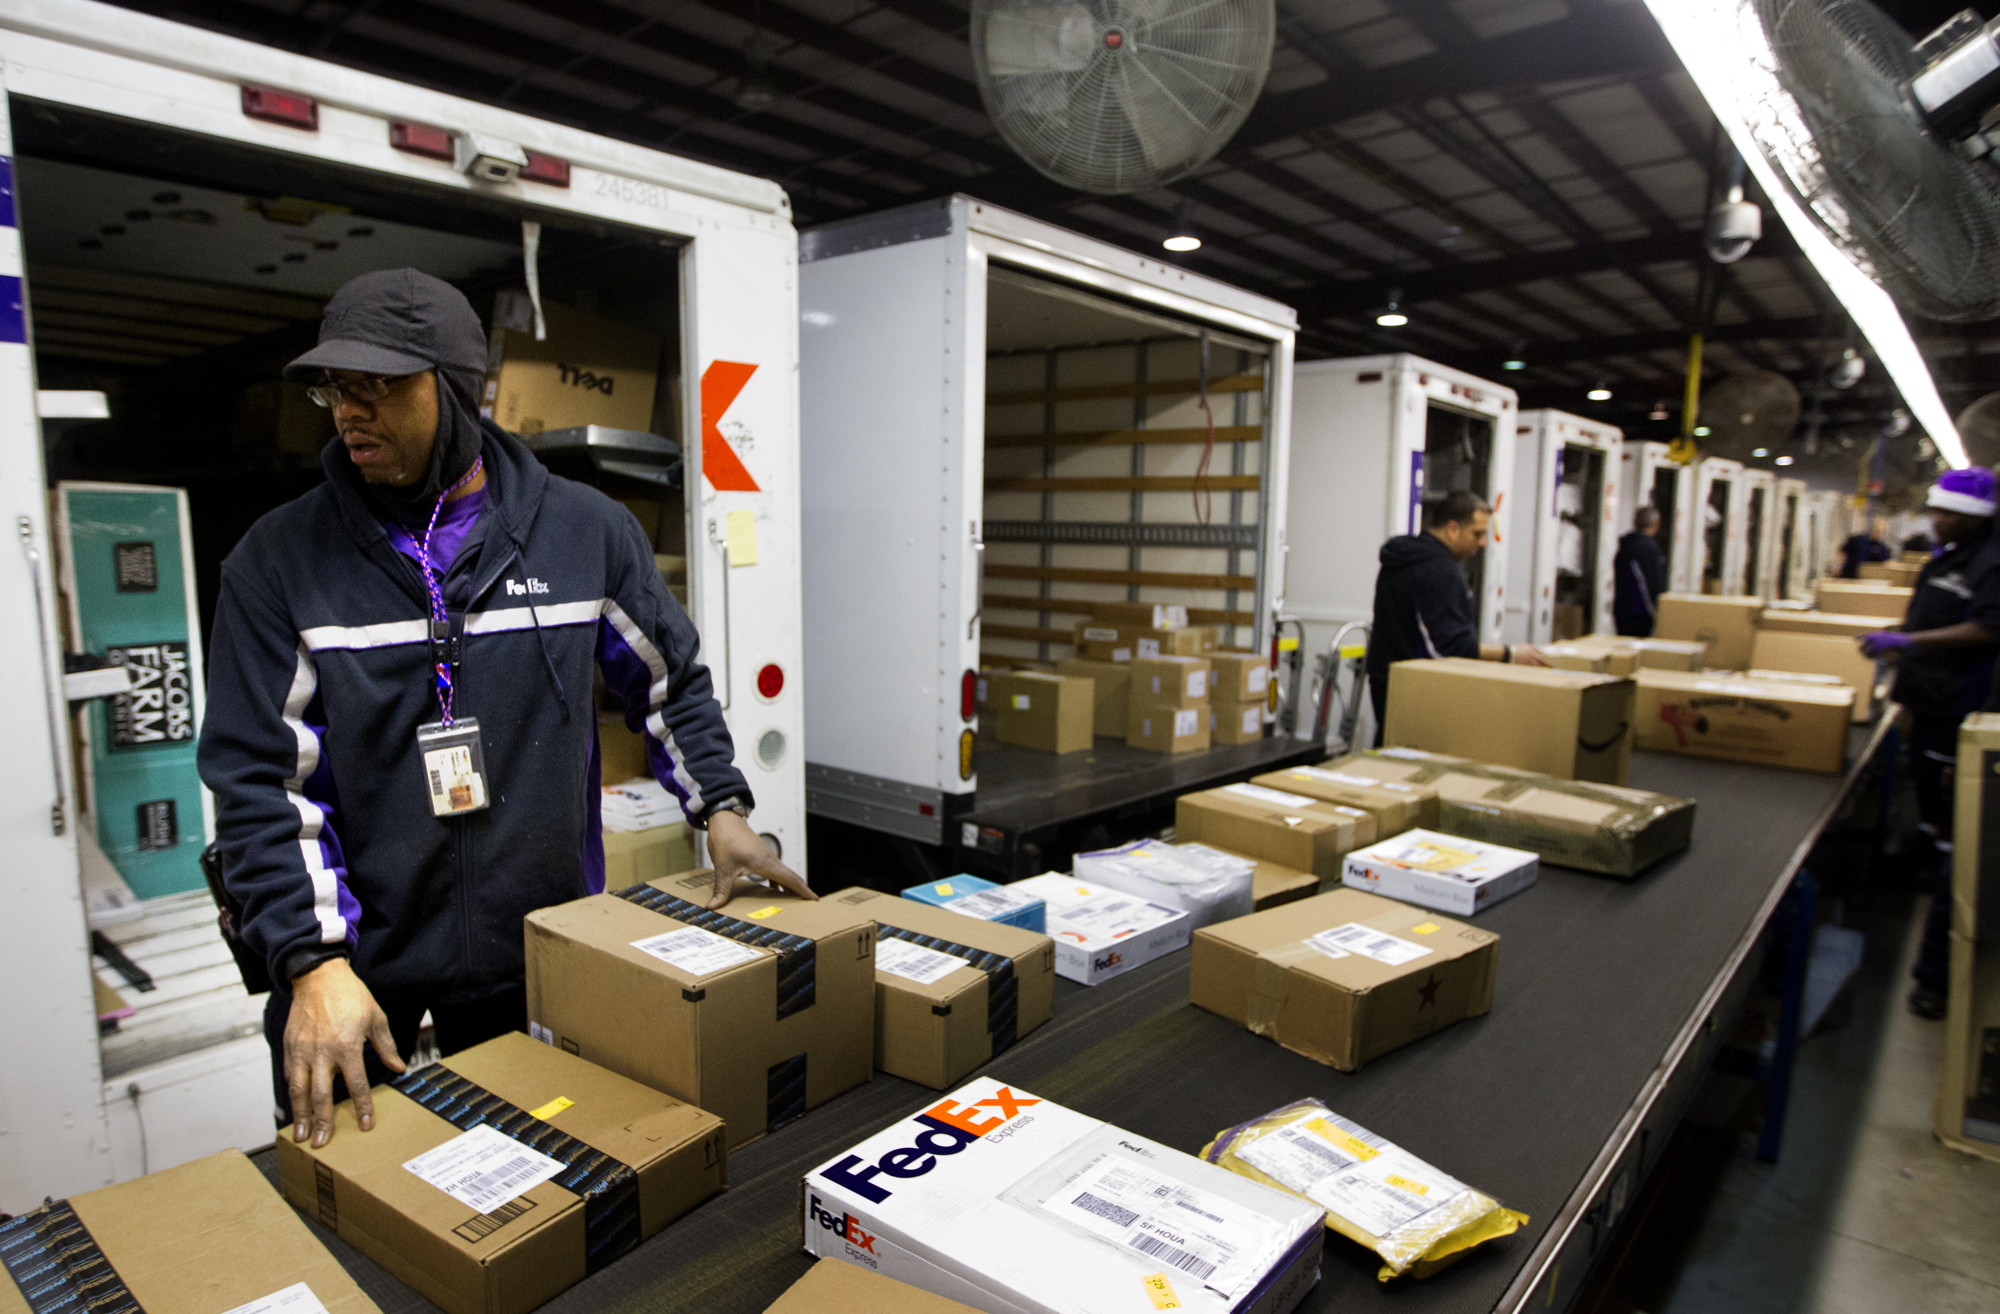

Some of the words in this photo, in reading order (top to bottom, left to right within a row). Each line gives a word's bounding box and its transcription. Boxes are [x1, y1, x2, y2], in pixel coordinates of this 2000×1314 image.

[595, 172, 670, 209] 245381
[557, 363, 615, 396] DELL
[127, 647, 165, 742] FARM
[161, 645, 193, 740] JACOBS
[1093, 952, 1122, 972] FedEx
[819, 1086, 1043, 1204] FedEx
[985, 1115, 1035, 1144] Express
[460, 1170, 483, 1186] HOUA
[810, 1194, 876, 1255] FedEx
[1139, 1221, 1153, 1231] SF
[1155, 1228, 1186, 1246] HOUA
[845, 1243, 879, 1270] Express
[29, 1277, 68, 1300] Prime
